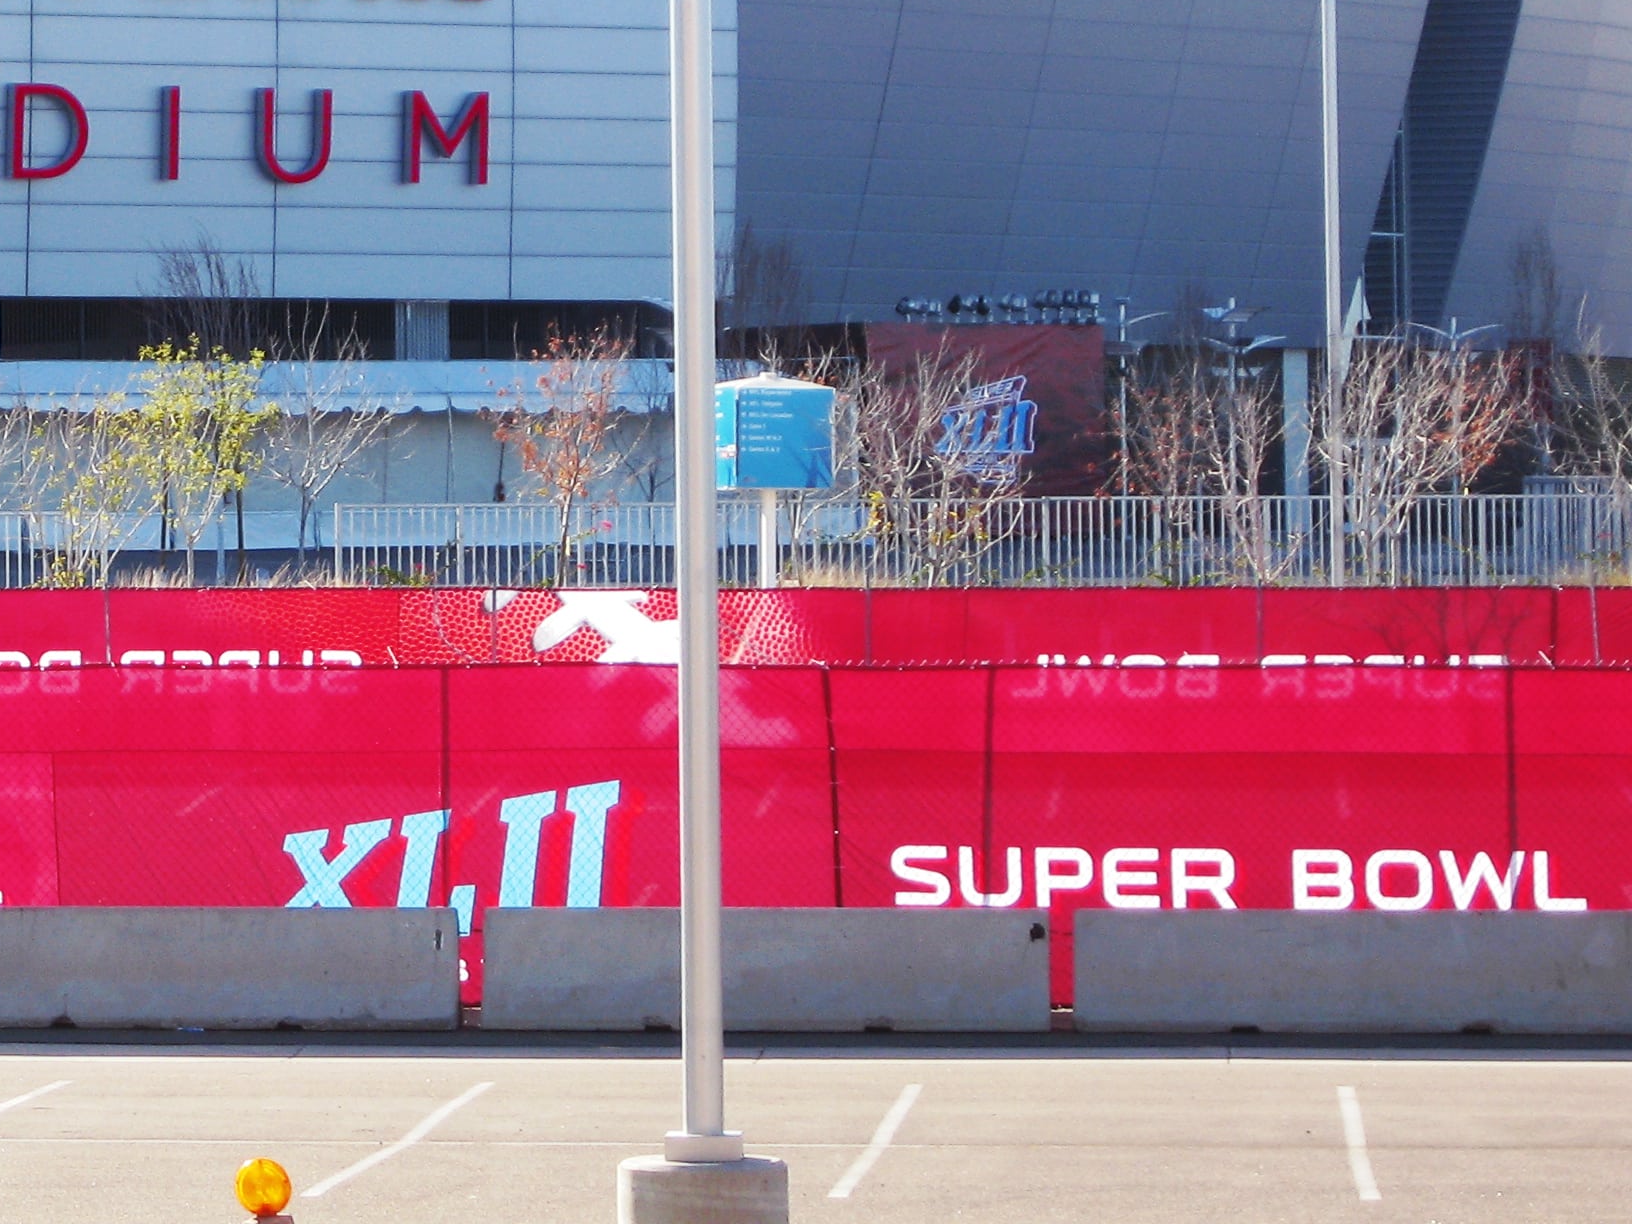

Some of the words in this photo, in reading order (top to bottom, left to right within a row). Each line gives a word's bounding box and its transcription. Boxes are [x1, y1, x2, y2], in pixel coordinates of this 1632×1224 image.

[282, 780, 621, 937] XLII
[890, 845, 1238, 909] SUPER
[1291, 849, 1588, 911] BOWL
